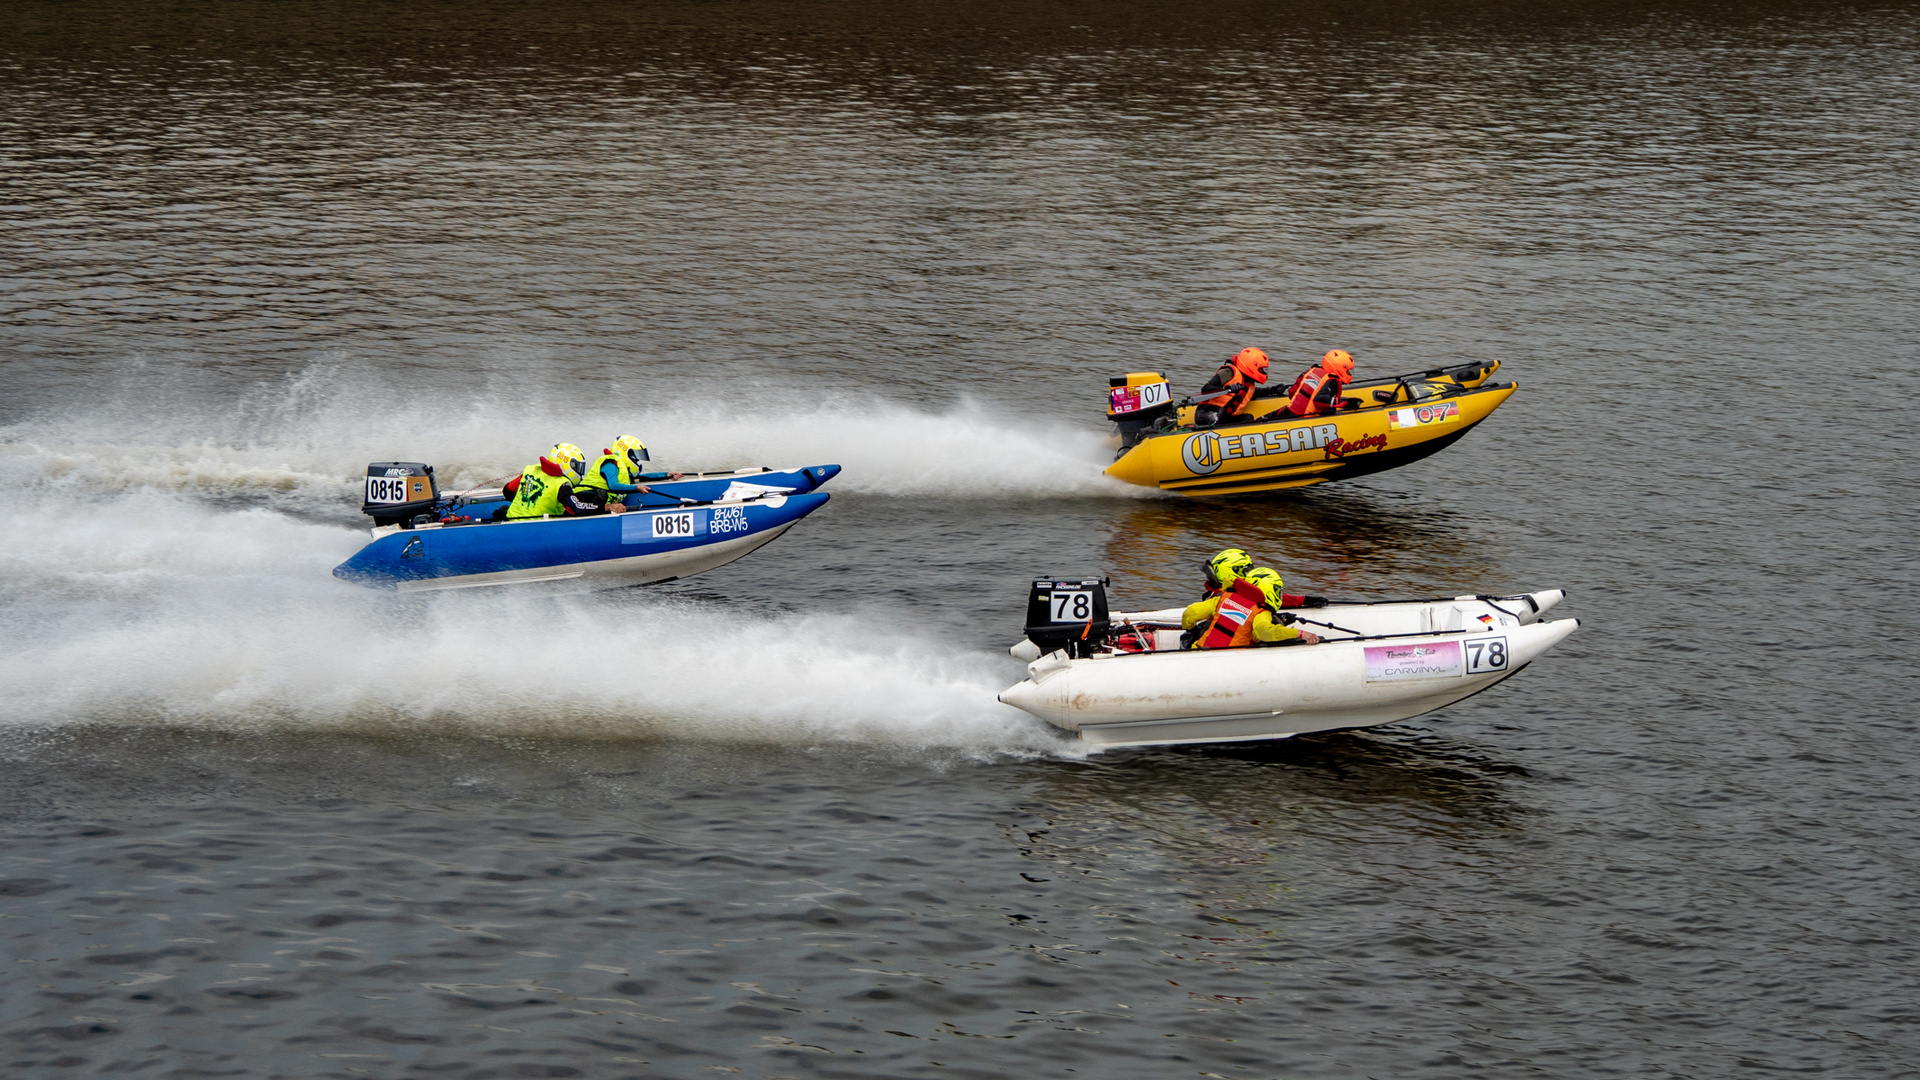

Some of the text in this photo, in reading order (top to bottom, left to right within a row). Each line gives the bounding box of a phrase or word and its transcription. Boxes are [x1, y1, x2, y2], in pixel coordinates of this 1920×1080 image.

[1144, 383, 1161, 404] 07
[1416, 403, 1450, 424] 07
[1182, 423, 1388, 475] CEASAR Racing
[371, 480, 403, 500] 0815
[655, 515, 691, 535] 0815
[710, 517, 749, 534] BRB-W5
[1053, 593, 1090, 620] 78
[1468, 642, 1505, 668] 78
[1384, 666, 1446, 676] CARVINYL
